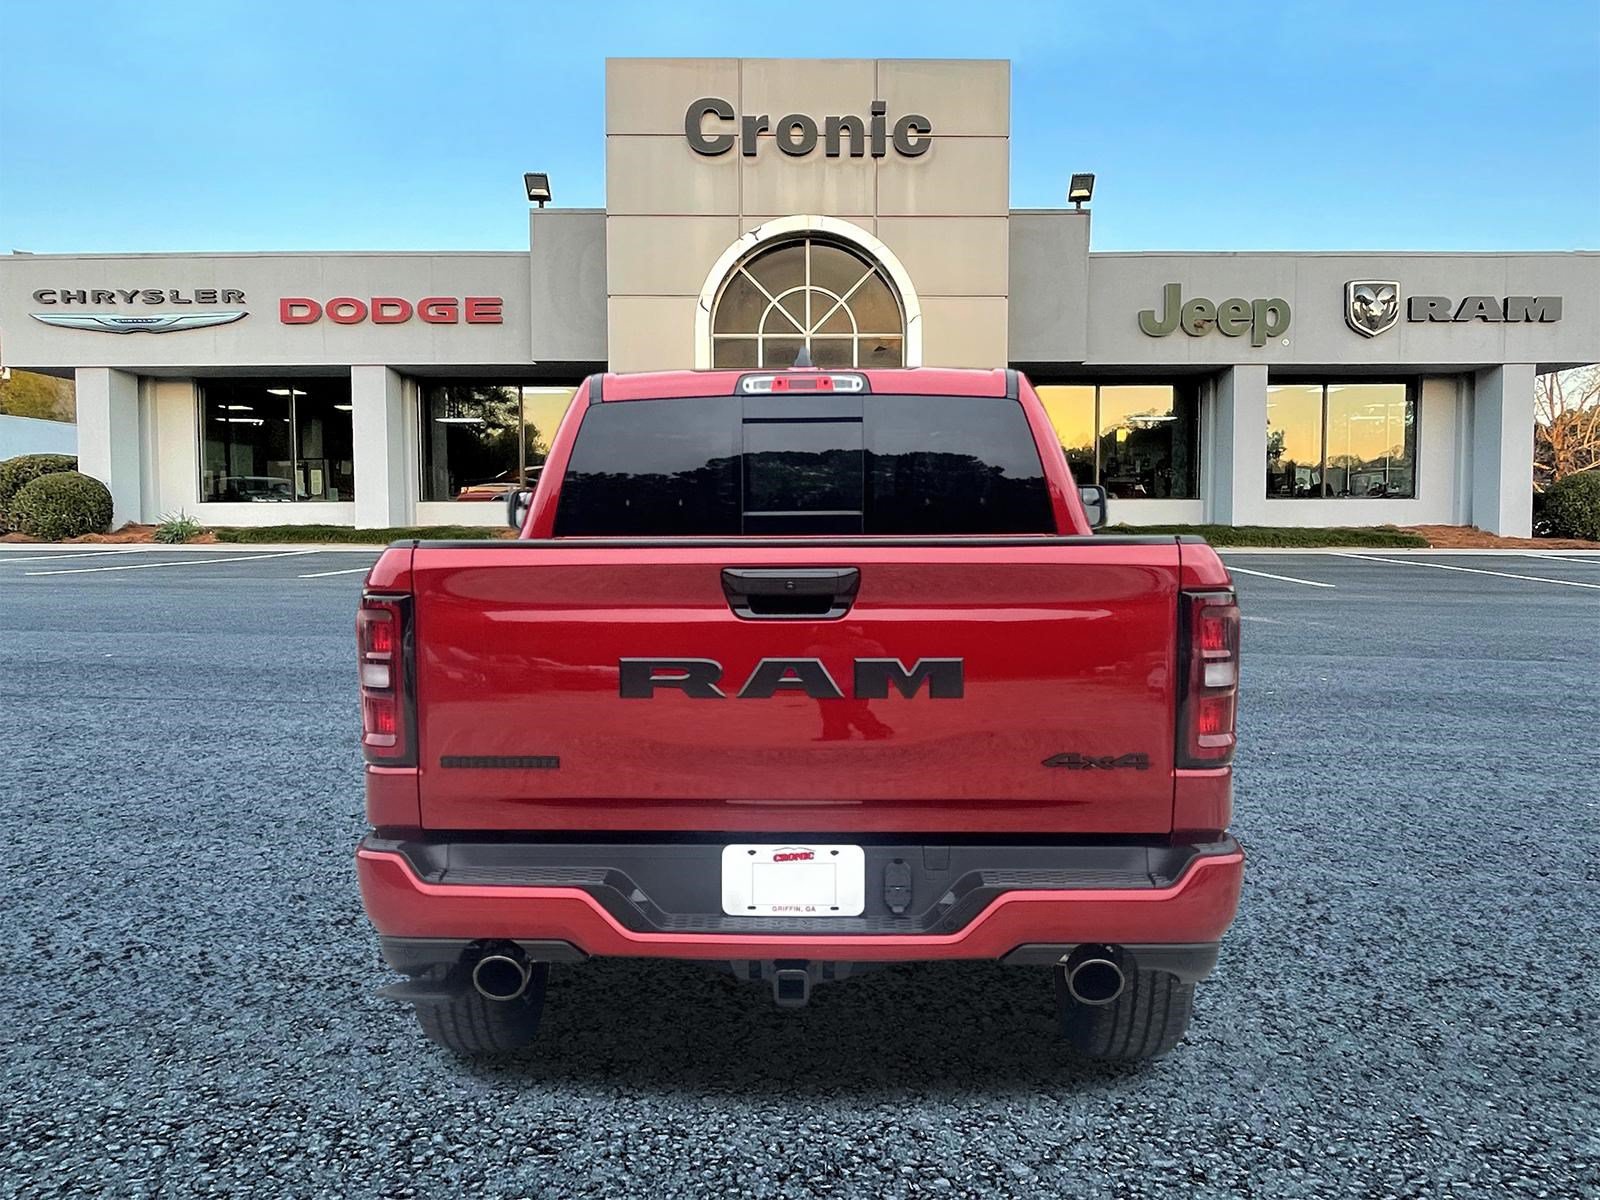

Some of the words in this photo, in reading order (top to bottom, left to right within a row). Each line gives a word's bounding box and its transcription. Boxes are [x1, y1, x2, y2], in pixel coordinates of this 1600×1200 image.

[685, 97, 932, 158] Cronic
[32, 288, 246, 304] CHRYSLER
[279, 296, 504, 325] DODGE
[1407, 296, 1563, 323] RAM
[1138, 283, 1292, 347] Jeep
[618, 657, 965, 699] RAM
[773, 851, 815, 862] CRONIC
